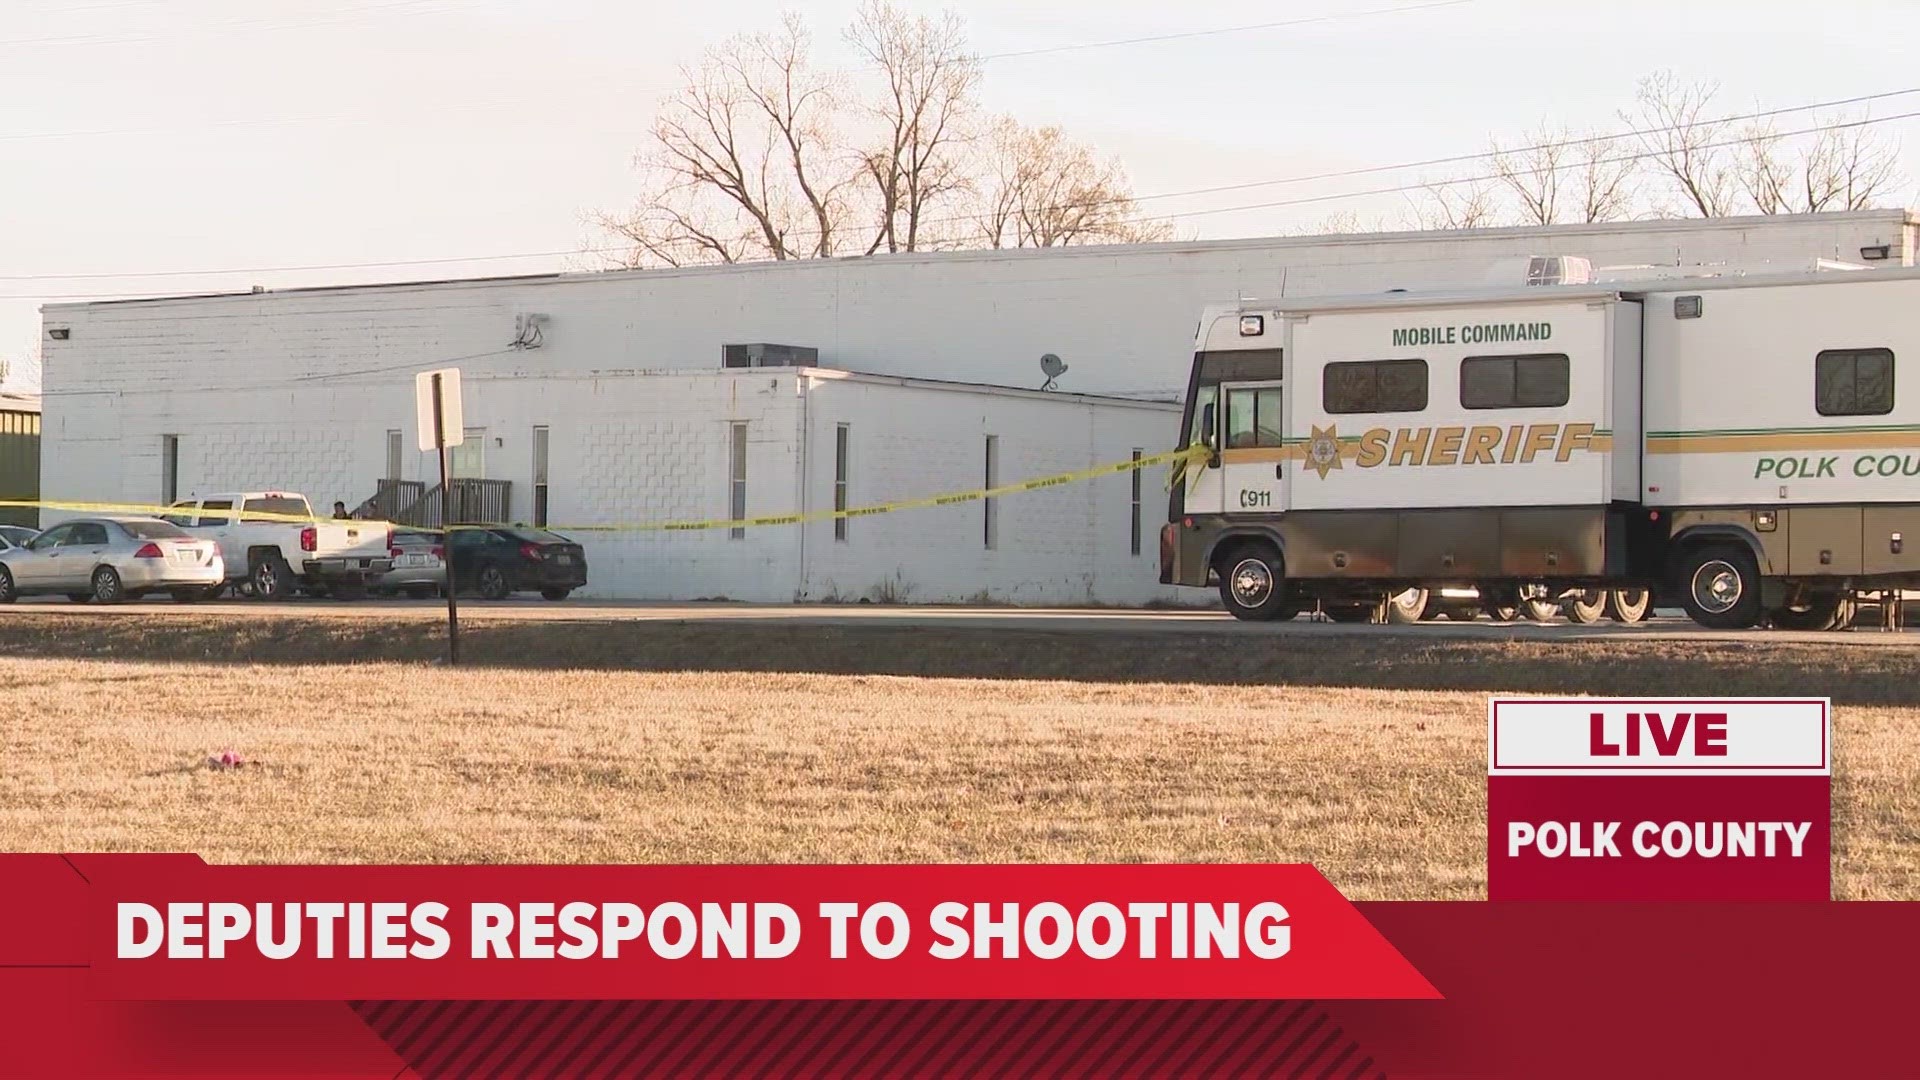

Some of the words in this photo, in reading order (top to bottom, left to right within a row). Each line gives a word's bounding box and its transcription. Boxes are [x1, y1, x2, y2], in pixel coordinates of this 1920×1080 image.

[1392, 327, 1456, 346] MOBILE
[1461, 323, 1552, 344] COMMAND
[1355, 423, 1596, 468] SHERIFF
[1754, 456, 1839, 479] POLK
[1248, 490, 1271, 507] 911
